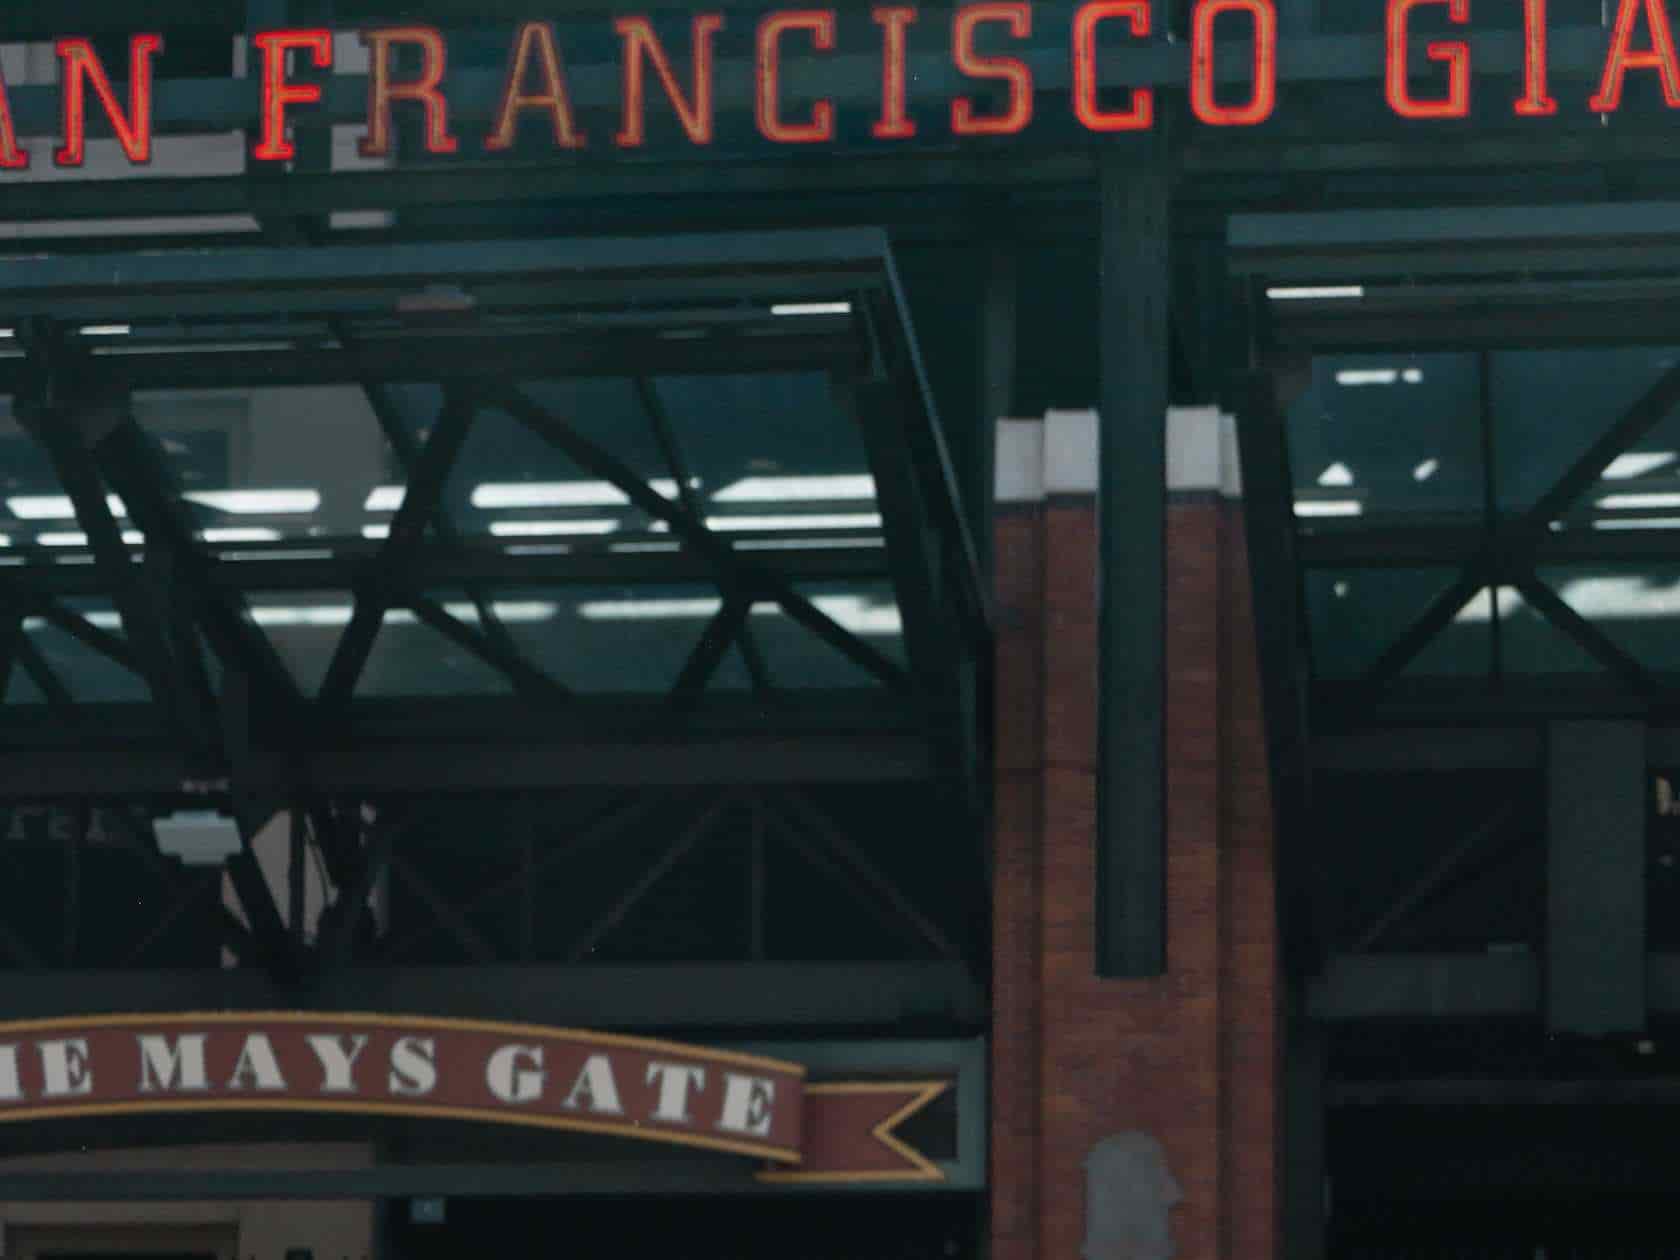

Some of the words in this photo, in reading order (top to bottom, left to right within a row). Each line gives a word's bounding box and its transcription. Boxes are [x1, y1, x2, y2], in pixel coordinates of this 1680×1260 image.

[0, 33, 160, 168] N
[251, 0, 1277, 161] FRANCISCO
[1383, 0, 1680, 119] GIA
[137, 1034, 437, 1094] MAYS
[485, 1044, 776, 1138] GATE
